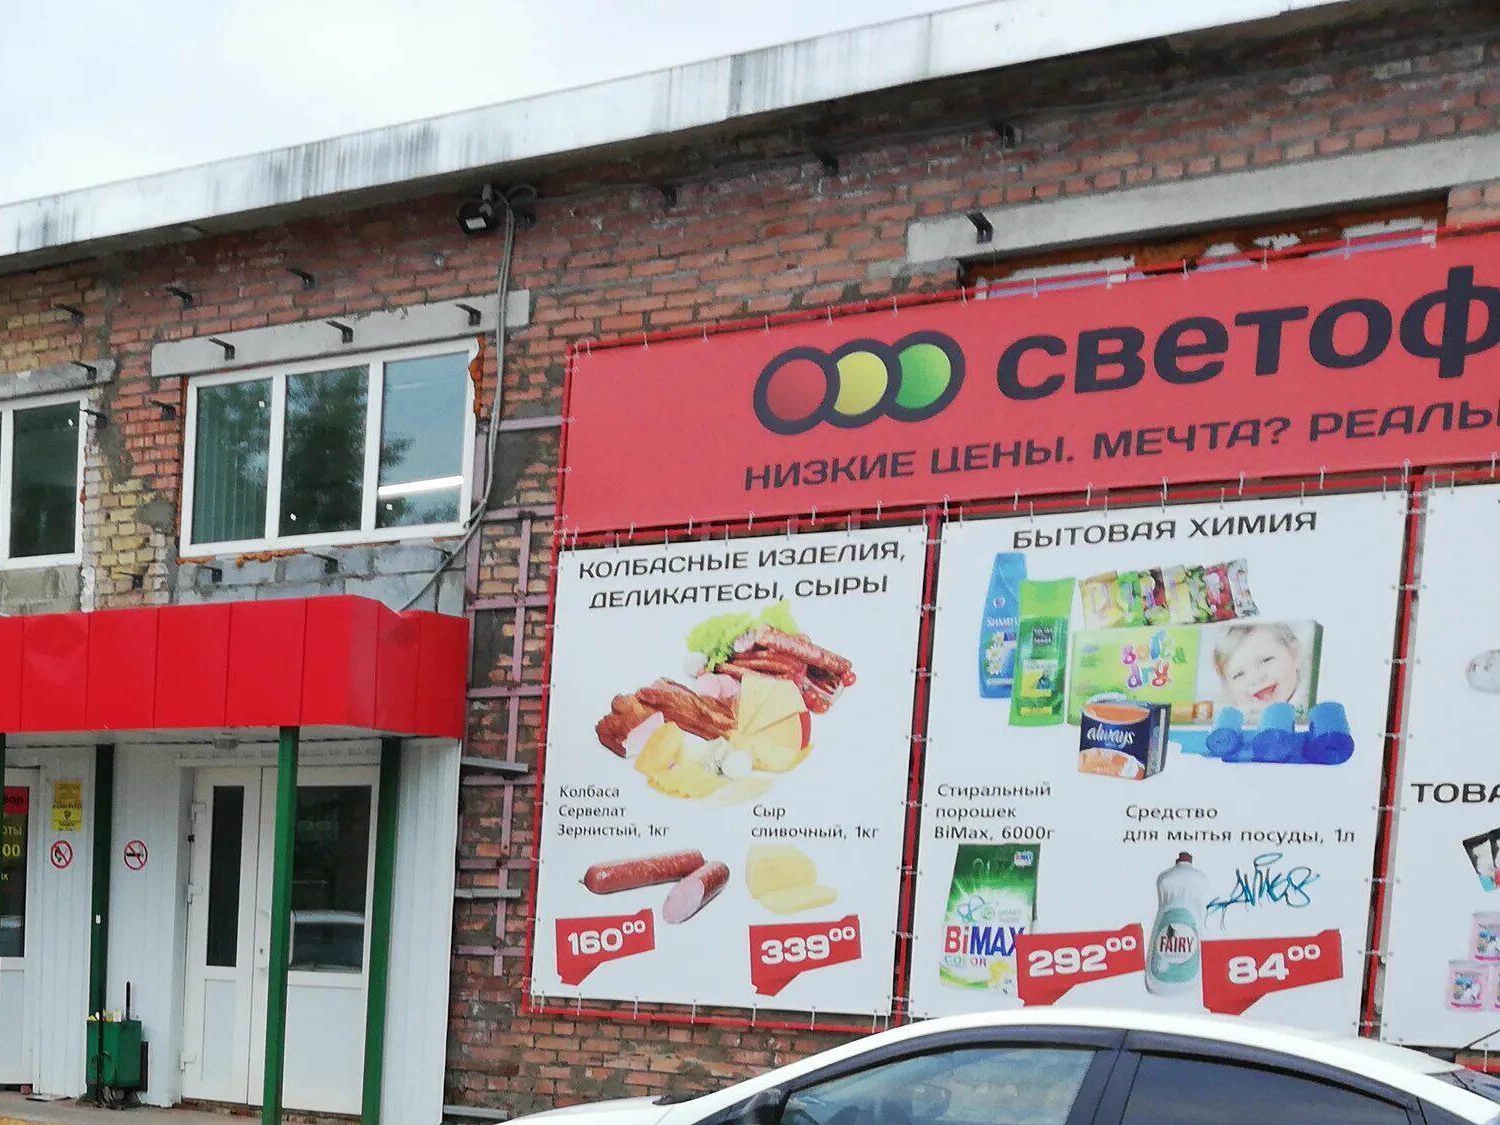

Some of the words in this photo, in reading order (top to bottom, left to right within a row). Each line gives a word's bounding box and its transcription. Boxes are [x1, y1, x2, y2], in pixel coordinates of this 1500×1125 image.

[744, 450, 916, 492] НИЗКИЕ
[930, 436, 1075, 476] ЦЕНЫ.
[1094, 416, 1290, 457] МЕЧТА?
[1309, 395, 1500, 443] РЕАЛЬ
[1012, 520, 1176, 549] БЫТОВАЯ
[1188, 511, 1318, 538] ХИМИЯ
[578, 551, 750, 580] КОЛБАСНЫЕ
[757, 541, 907, 568] ИЗДЕЛИЯ,
[588, 581, 785, 610] ДЕЛИКАТЕСЫ,
[794, 575, 889, 598] СЫРЫ
[1086, 722, 1135, 749] always
[559, 785, 620, 799] Колбаса
[937, 782, 1052, 800] Стиральный
[558, 804, 627, 820] Сервелат
[753, 804, 787, 820] Сыр
[935, 807, 1017, 820] порошек
[1125, 804, 1218, 821] Средство
[556, 822, 642, 839] Зернистый,
[647, 823, 670, 837] 1кг
[750, 824, 848, 840] сливочный,
[854, 825, 880, 840] 1кг
[934, 826, 994, 841] BiMax,
[1001, 826, 1055, 841] 6000г
[1123, 829, 1159, 843] для
[1167, 829, 1232, 842] мытья
[1240, 829, 1325, 845] посуды,
[1334, 828, 1356, 843] 1л
[944, 926, 1025, 957] BiMAX
[1160, 936, 1194, 953] FAIRY
